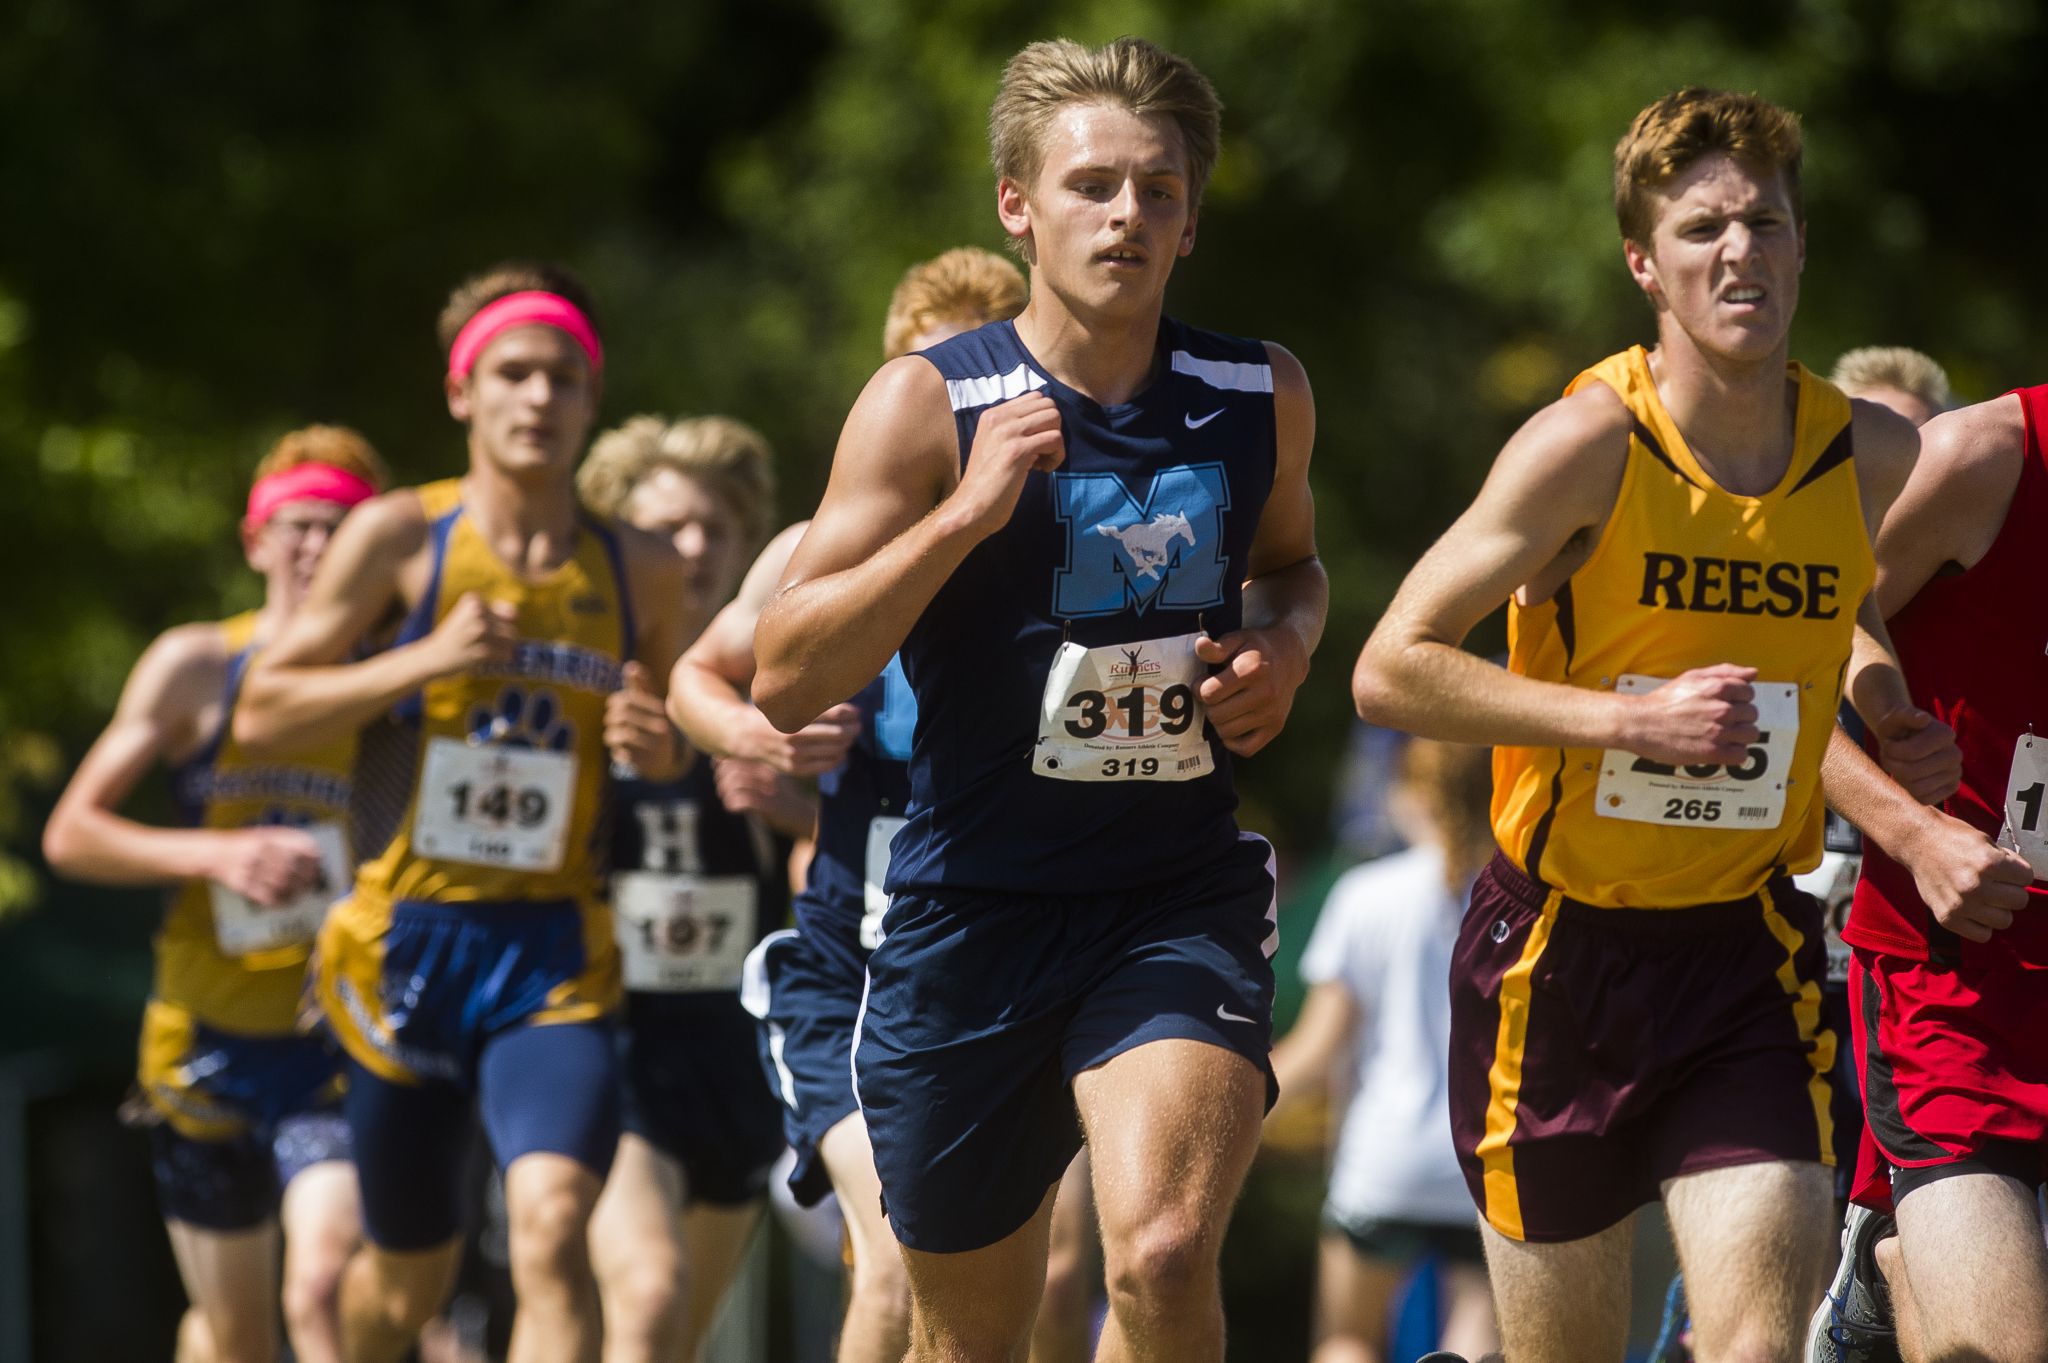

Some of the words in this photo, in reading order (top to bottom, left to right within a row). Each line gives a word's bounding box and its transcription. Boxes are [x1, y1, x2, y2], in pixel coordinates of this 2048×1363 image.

[1052, 461, 1232, 620] M
[1638, 551, 1841, 620] REESE
[1110, 661, 1161, 674] Runers
[1064, 683, 1194, 739] 319
[1101, 757, 1159, 777] 319
[447, 776, 549, 831] 149
[1663, 798, 1722, 822] 265
[634, 803, 701, 873] H
